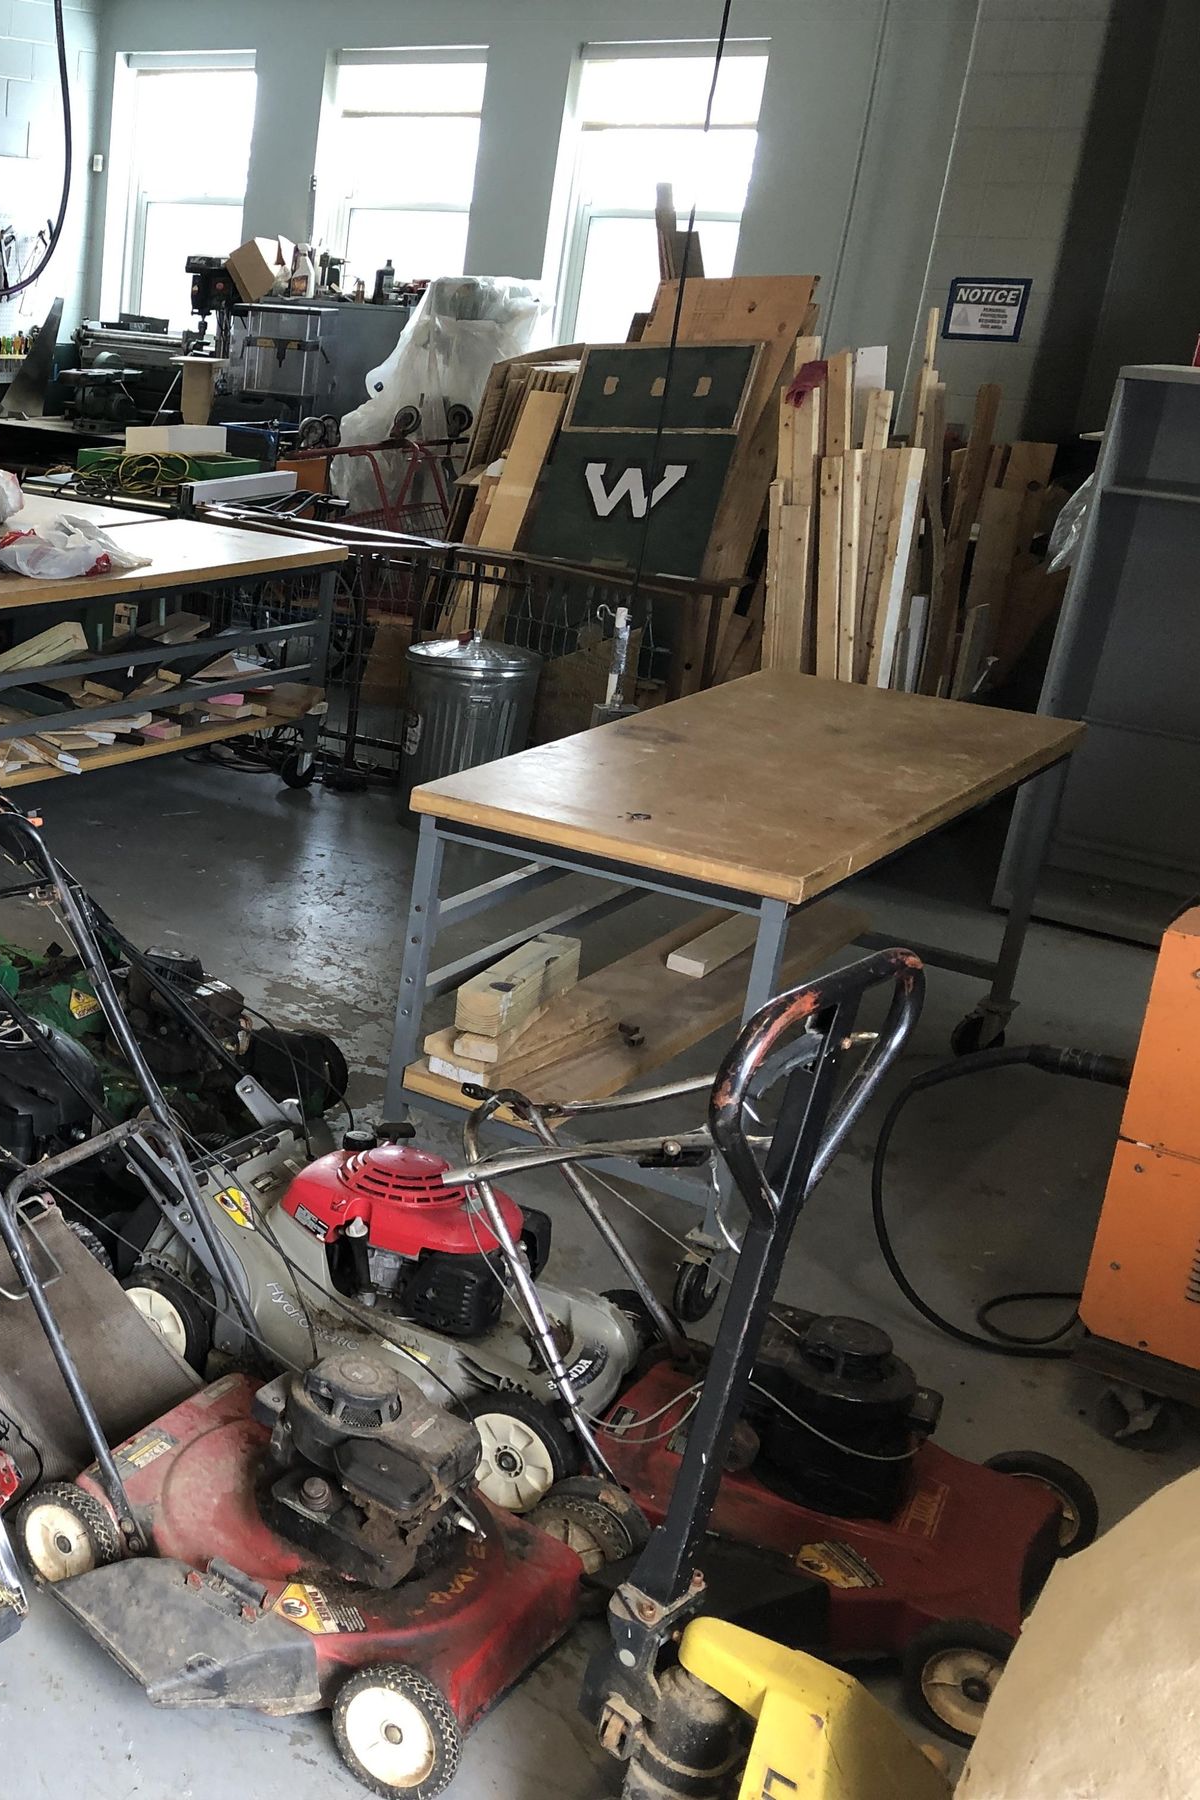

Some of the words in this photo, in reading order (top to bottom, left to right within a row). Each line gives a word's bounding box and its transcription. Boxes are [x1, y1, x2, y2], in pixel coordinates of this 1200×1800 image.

[956, 287, 1020, 304] NOTICE
[585, 462, 688, 518] W
[544, 1359, 594, 1391] HNDA
[308, 1591, 332, 1622] DANGER
